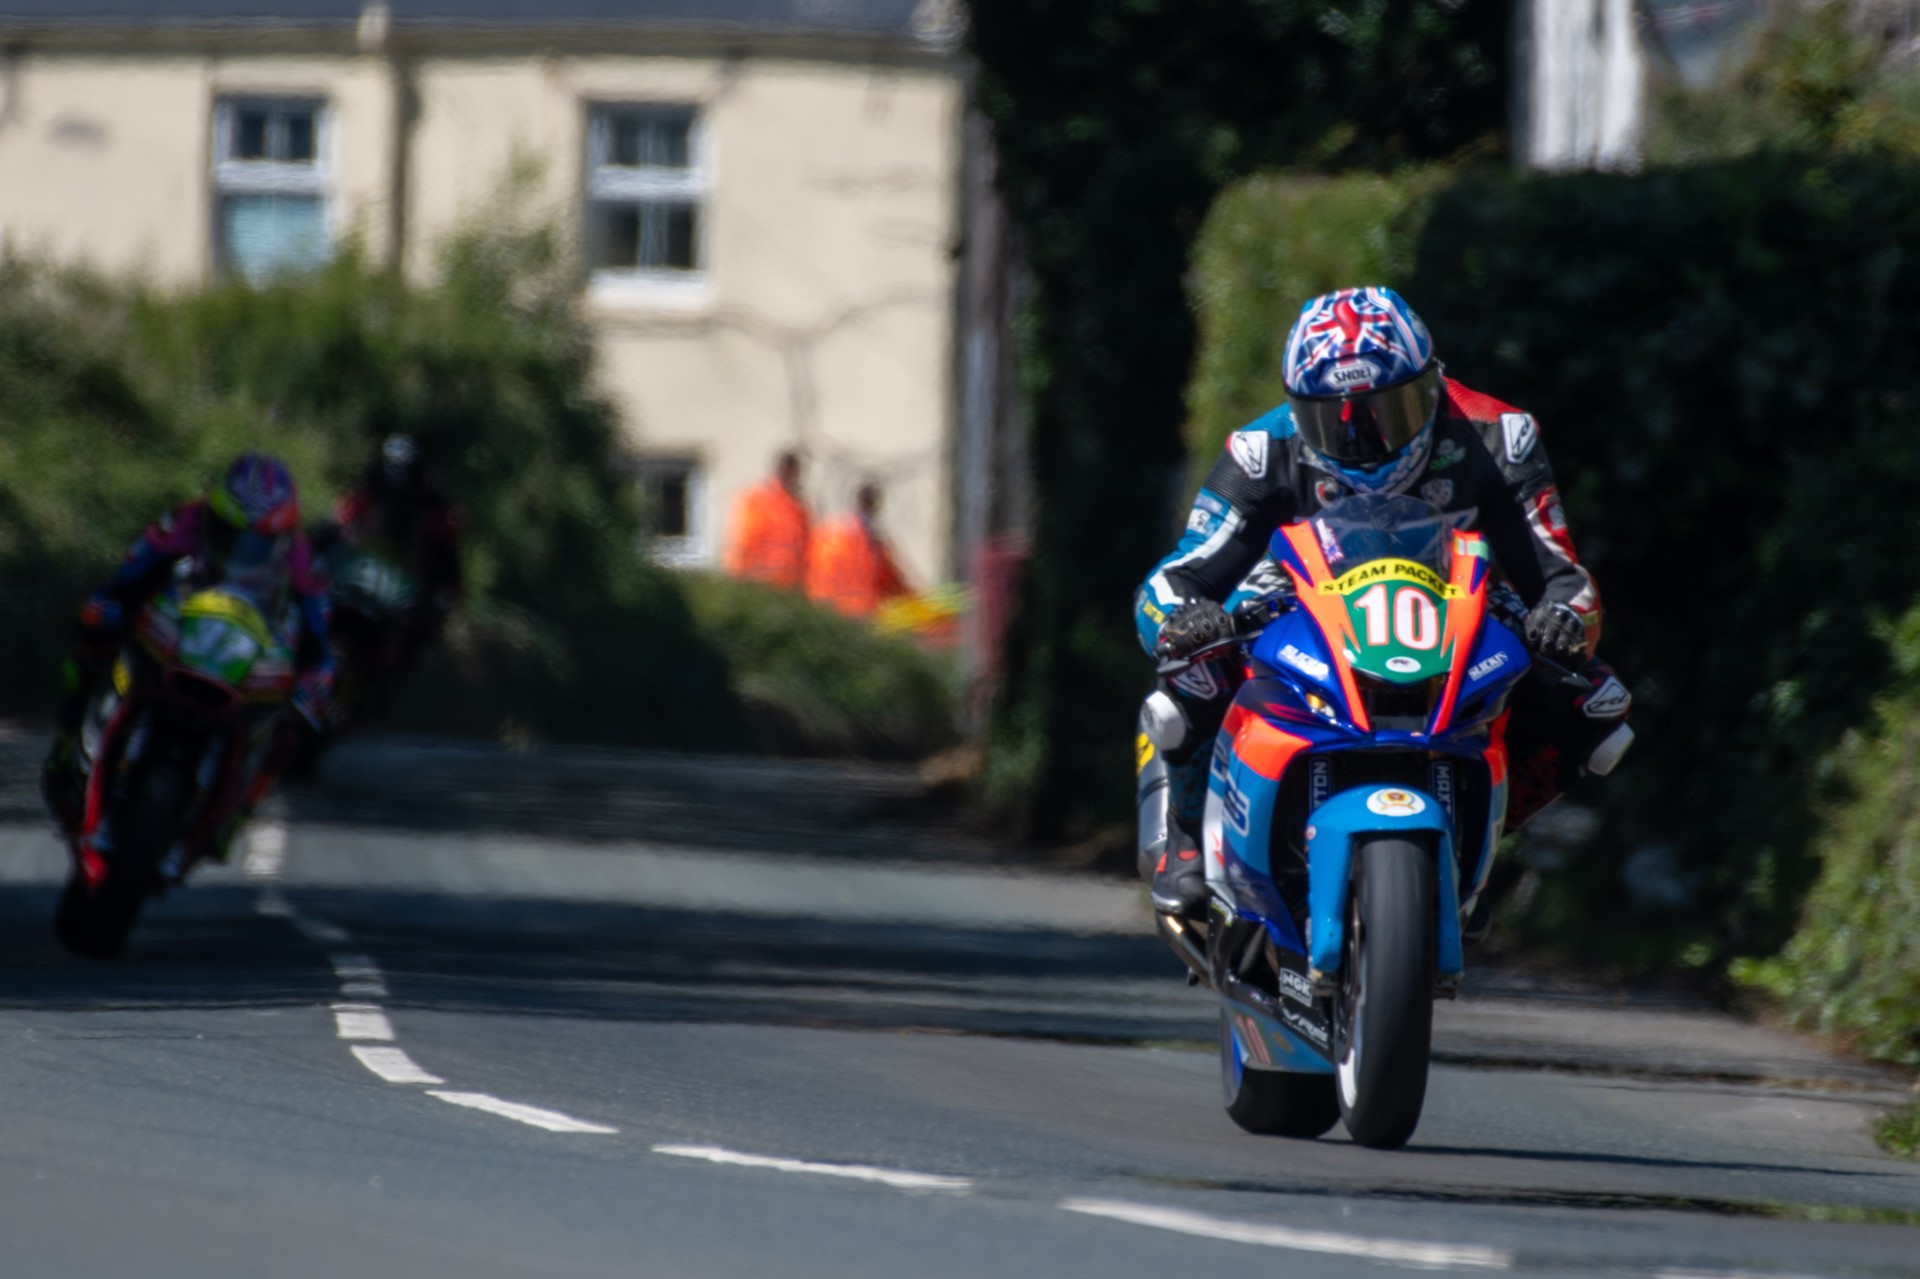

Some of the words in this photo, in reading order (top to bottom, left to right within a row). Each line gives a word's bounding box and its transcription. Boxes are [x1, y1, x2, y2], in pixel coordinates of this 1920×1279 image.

[1323, 565, 1387, 592] STEAM
[1394, 563, 1458, 595] PACKET
[1354, 583, 1439, 650] 10
[1282, 973, 1311, 996] NGK
